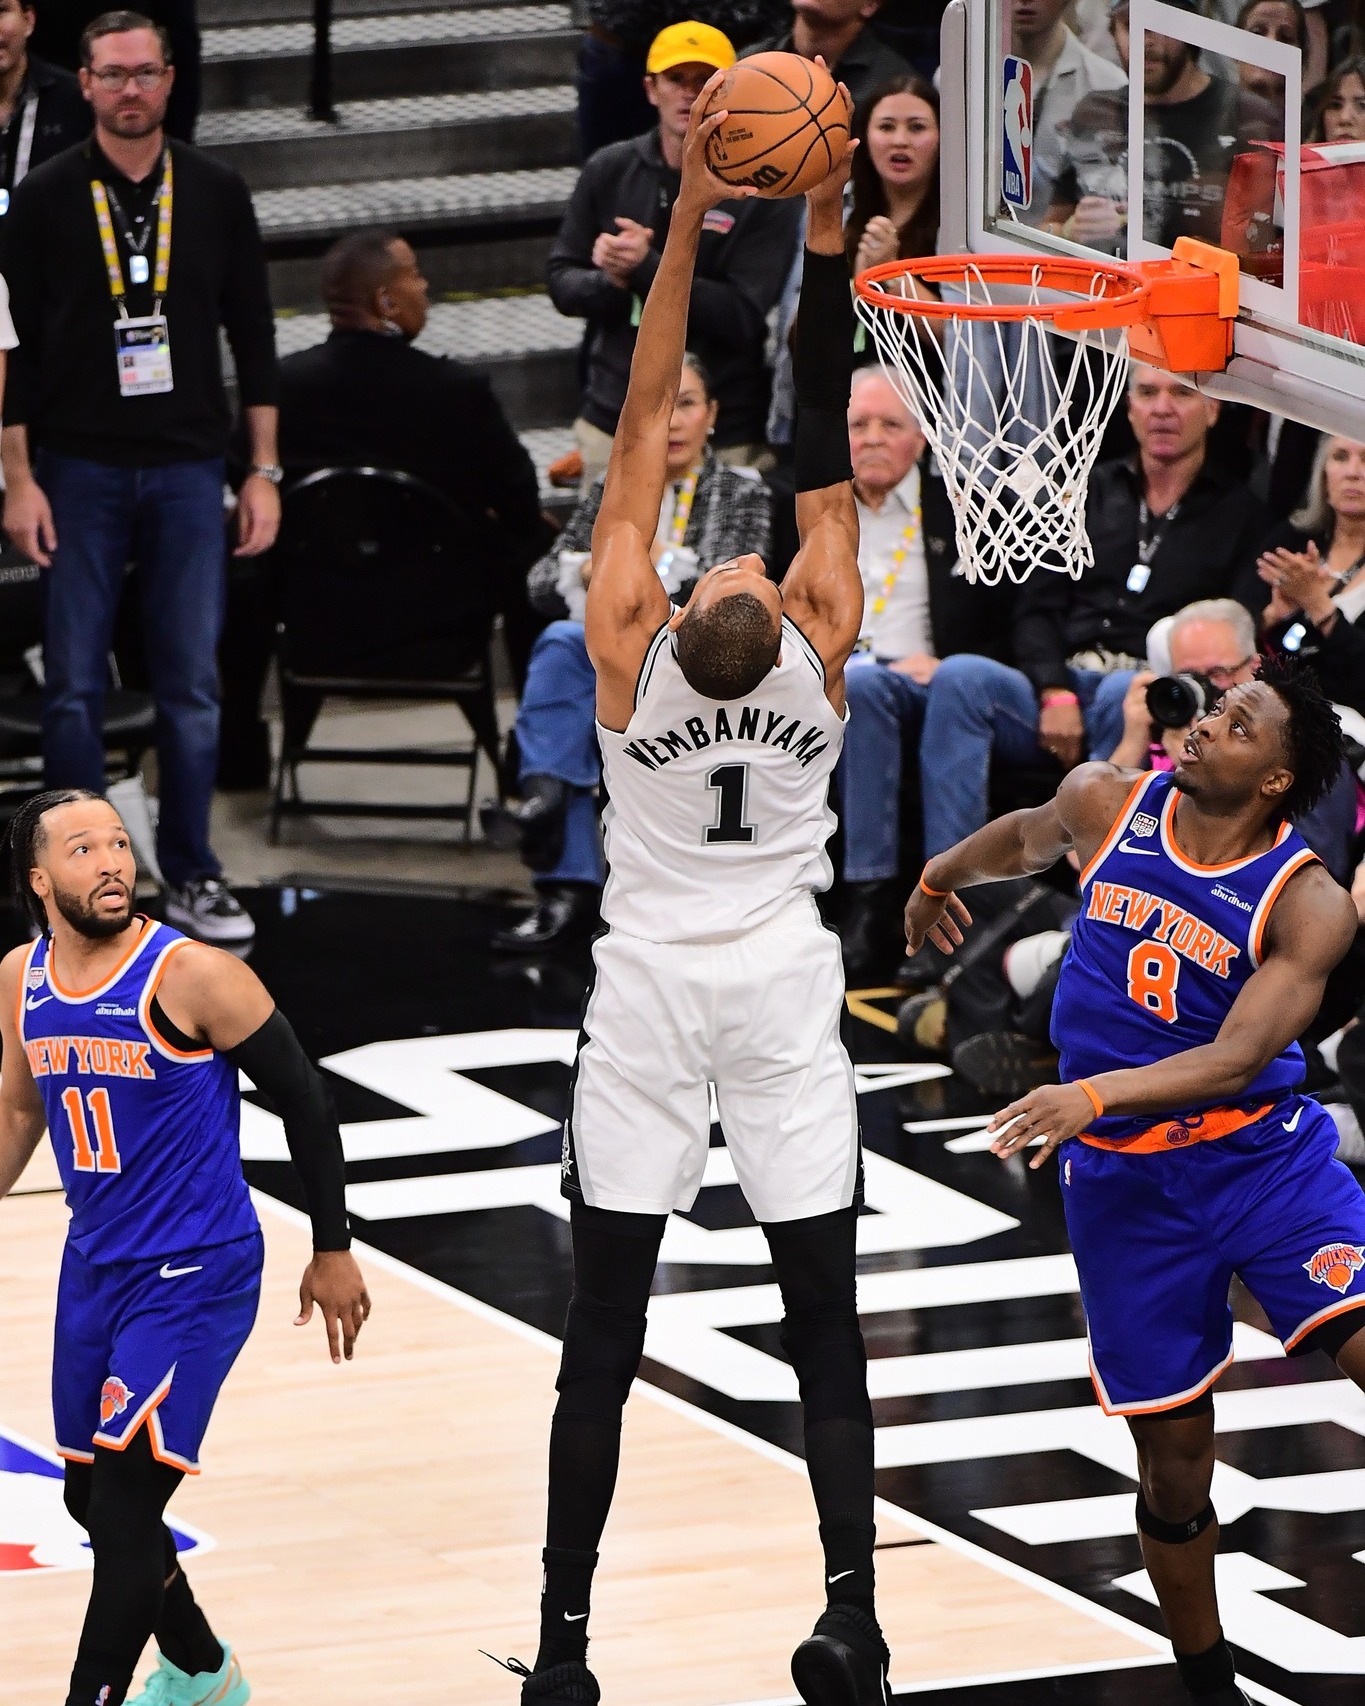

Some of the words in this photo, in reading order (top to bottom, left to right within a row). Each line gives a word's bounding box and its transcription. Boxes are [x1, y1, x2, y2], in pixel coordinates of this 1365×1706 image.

[1005, 170, 1021, 197] NBA
[622, 706, 829, 771] WEMBANYAMA
[701, 762, 758, 846] 1
[1086, 881, 1160, 931] NEW
[1152, 898, 1241, 980] YORK
[1210, 888, 1229, 901] abu
[1227, 896, 1254, 913] dhabi
[1127, 939, 1180, 1024] 8
[25, 1036, 70, 1079] NEW
[71, 1036, 156, 1080] YORK
[61, 1086, 121, 1174] 11
[1311, 1245, 1363, 1279] KNICKS
